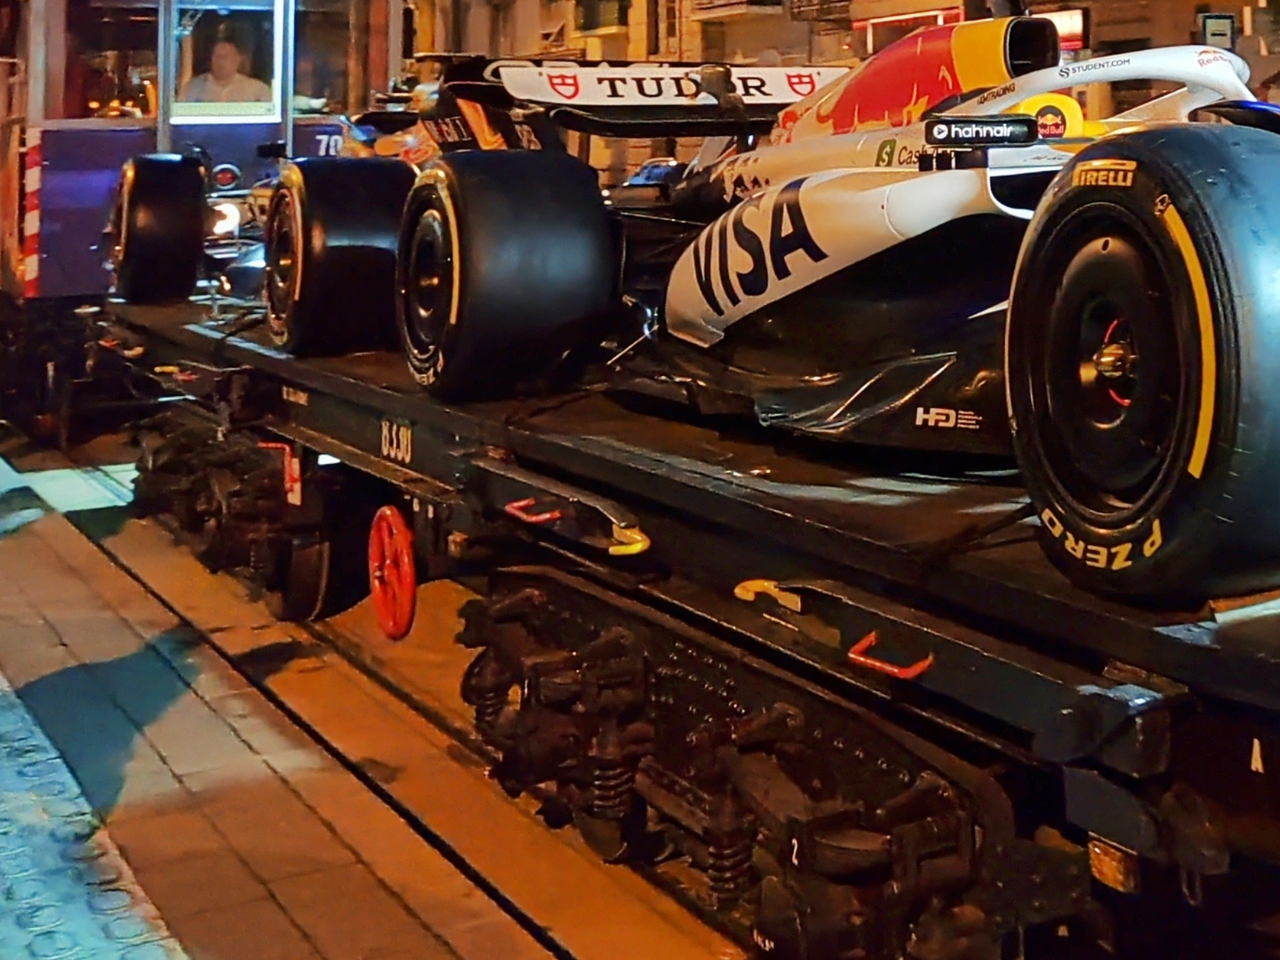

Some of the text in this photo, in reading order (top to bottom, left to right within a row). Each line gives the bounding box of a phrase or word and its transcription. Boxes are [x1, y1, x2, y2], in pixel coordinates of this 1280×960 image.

[1071, 58, 1131, 75] STUDENT.COM
[597, 75, 772, 98] TUDR
[951, 123, 1013, 139] hahnair
[1072, 159, 1137, 187] PIRELLI
[693, 177, 829, 317] VISA
[1251, 738, 1265, 774] A
